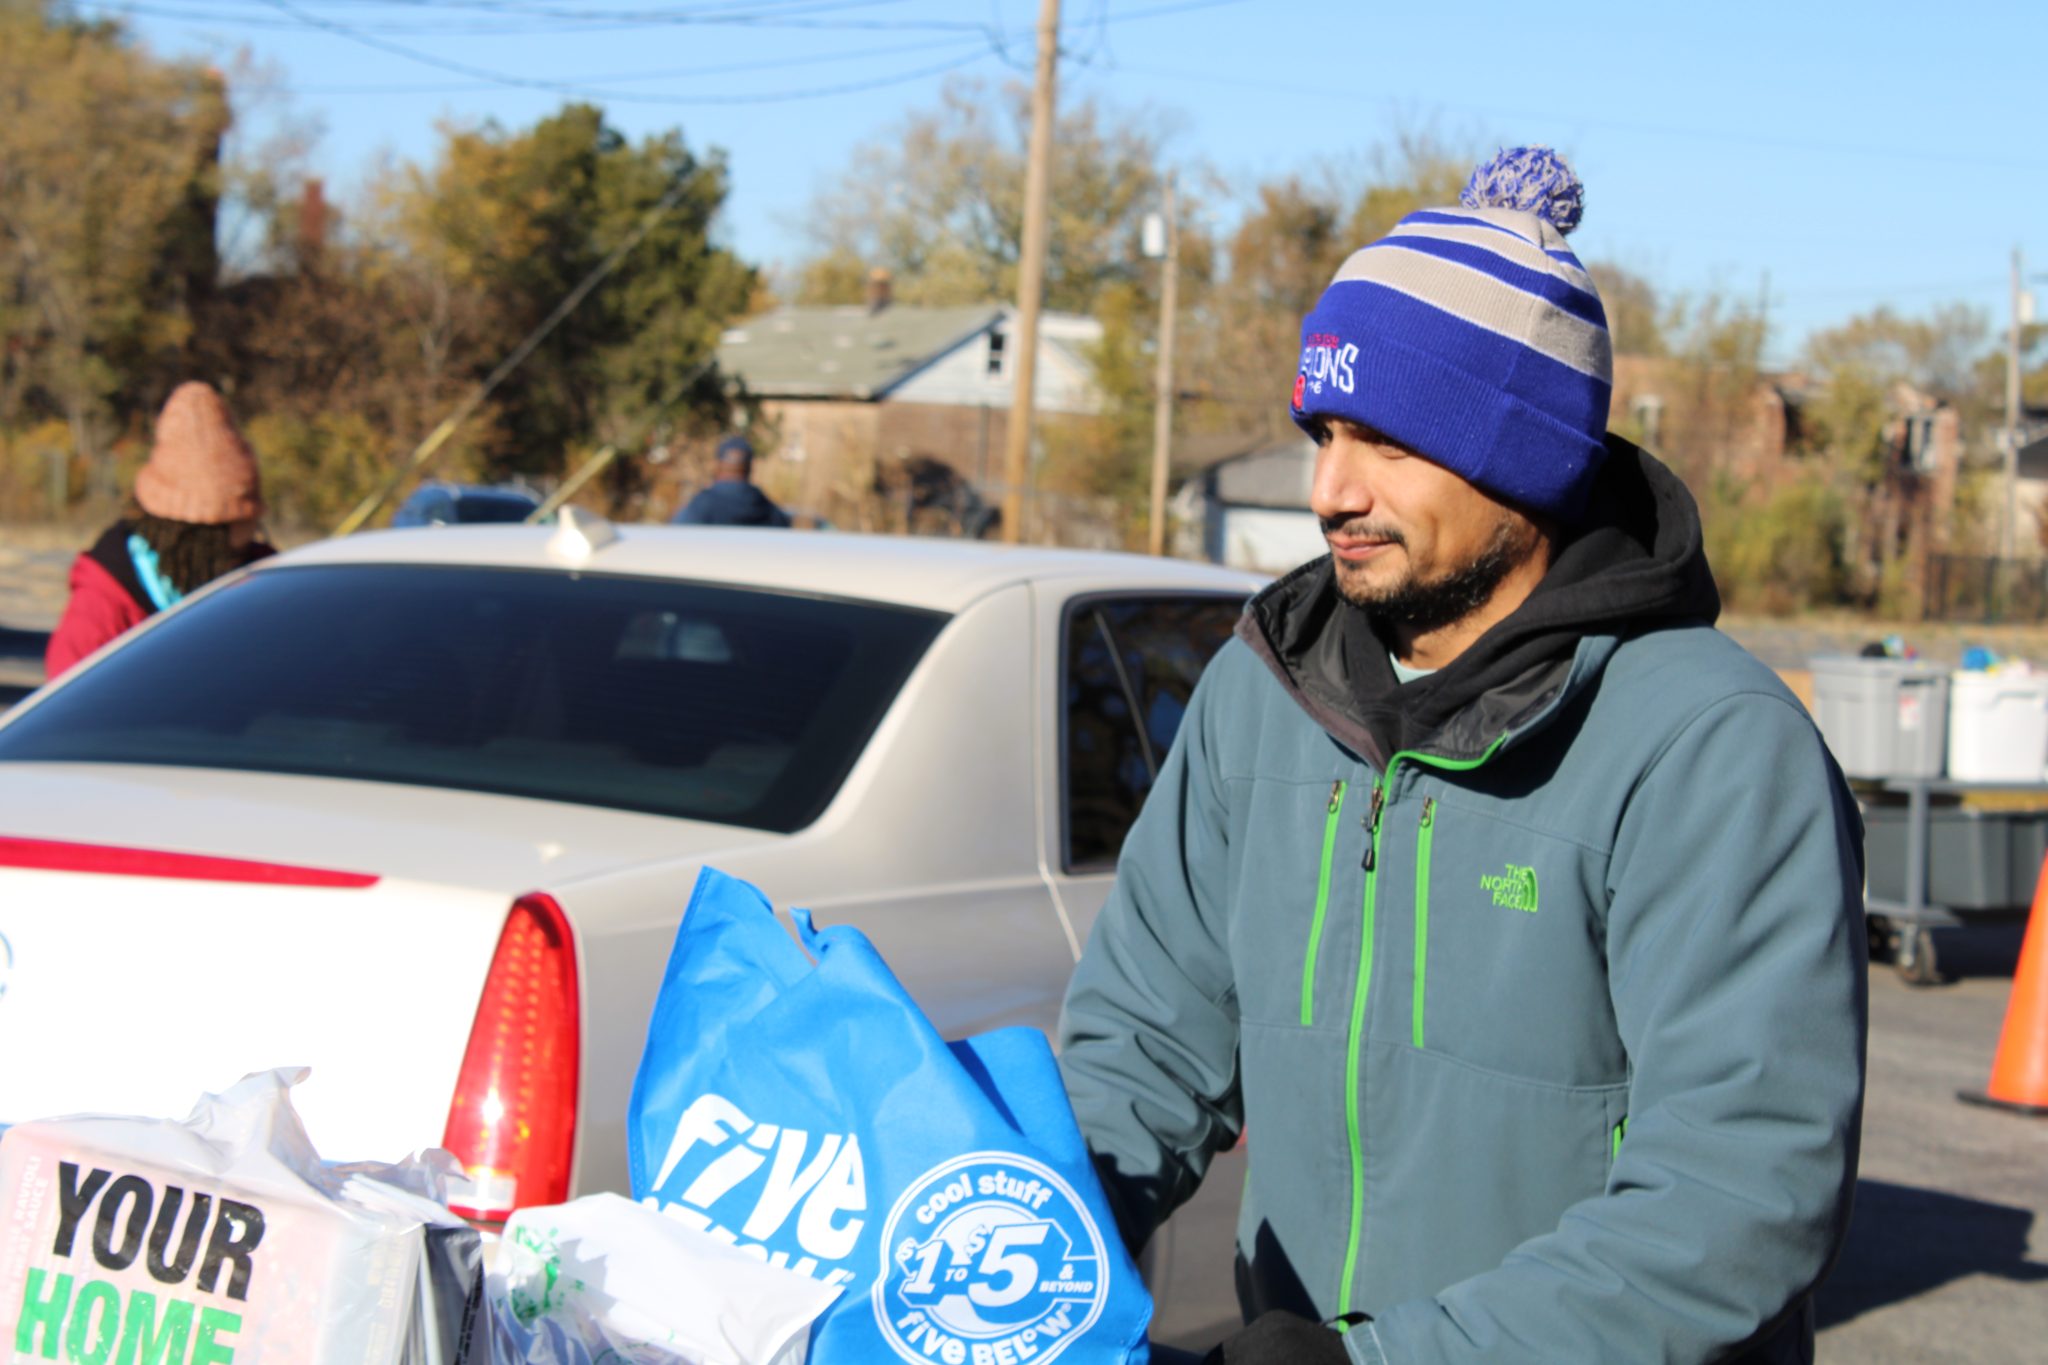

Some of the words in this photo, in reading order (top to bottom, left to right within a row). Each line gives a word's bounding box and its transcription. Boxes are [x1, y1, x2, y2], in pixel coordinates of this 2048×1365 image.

[1504, 863, 1528, 880] THE
[1480, 874, 1523, 894] NORTH
[1492, 891, 1522, 910] FACE
[23, 1178, 49, 1231] SAUCE
[916, 1173, 973, 1224] cool
[978, 1170, 1053, 1210] stuff
[53, 1161, 266, 1302] YOUR
[944, 1267, 968, 1282] TO
[1058, 1263, 1075, 1281] &
[1038, 1280, 1094, 1294] BEYOND
[15, 1267, 243, 1365] HOME
